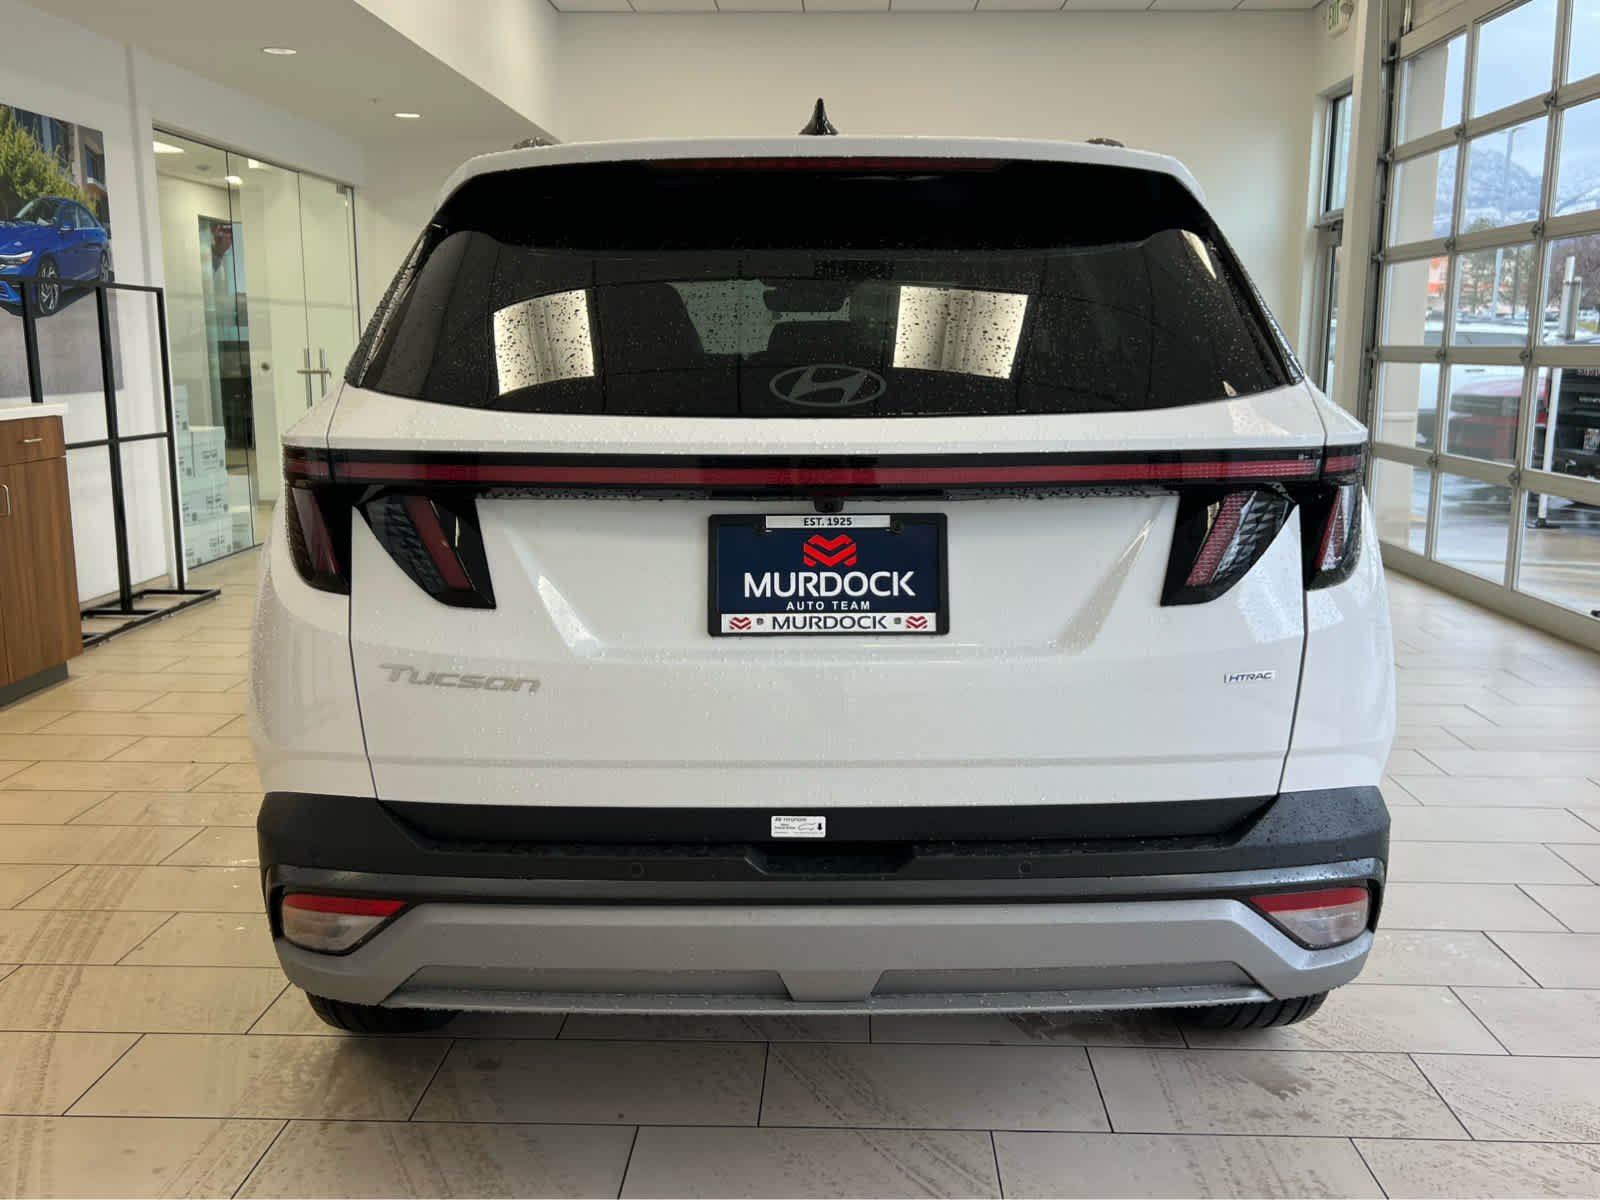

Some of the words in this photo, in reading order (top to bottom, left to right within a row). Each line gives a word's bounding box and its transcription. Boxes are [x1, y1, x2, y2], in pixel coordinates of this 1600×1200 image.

[803, 517, 825, 527] EST.
[827, 517, 853, 526] 1925
[744, 571, 916, 598] MURDOCK
[786, 601, 825, 611] AUTO
[832, 601, 871, 610] TEAM
[772, 615, 888, 630] MURDOCK
[1229, 672, 1273, 682] HTRAC
